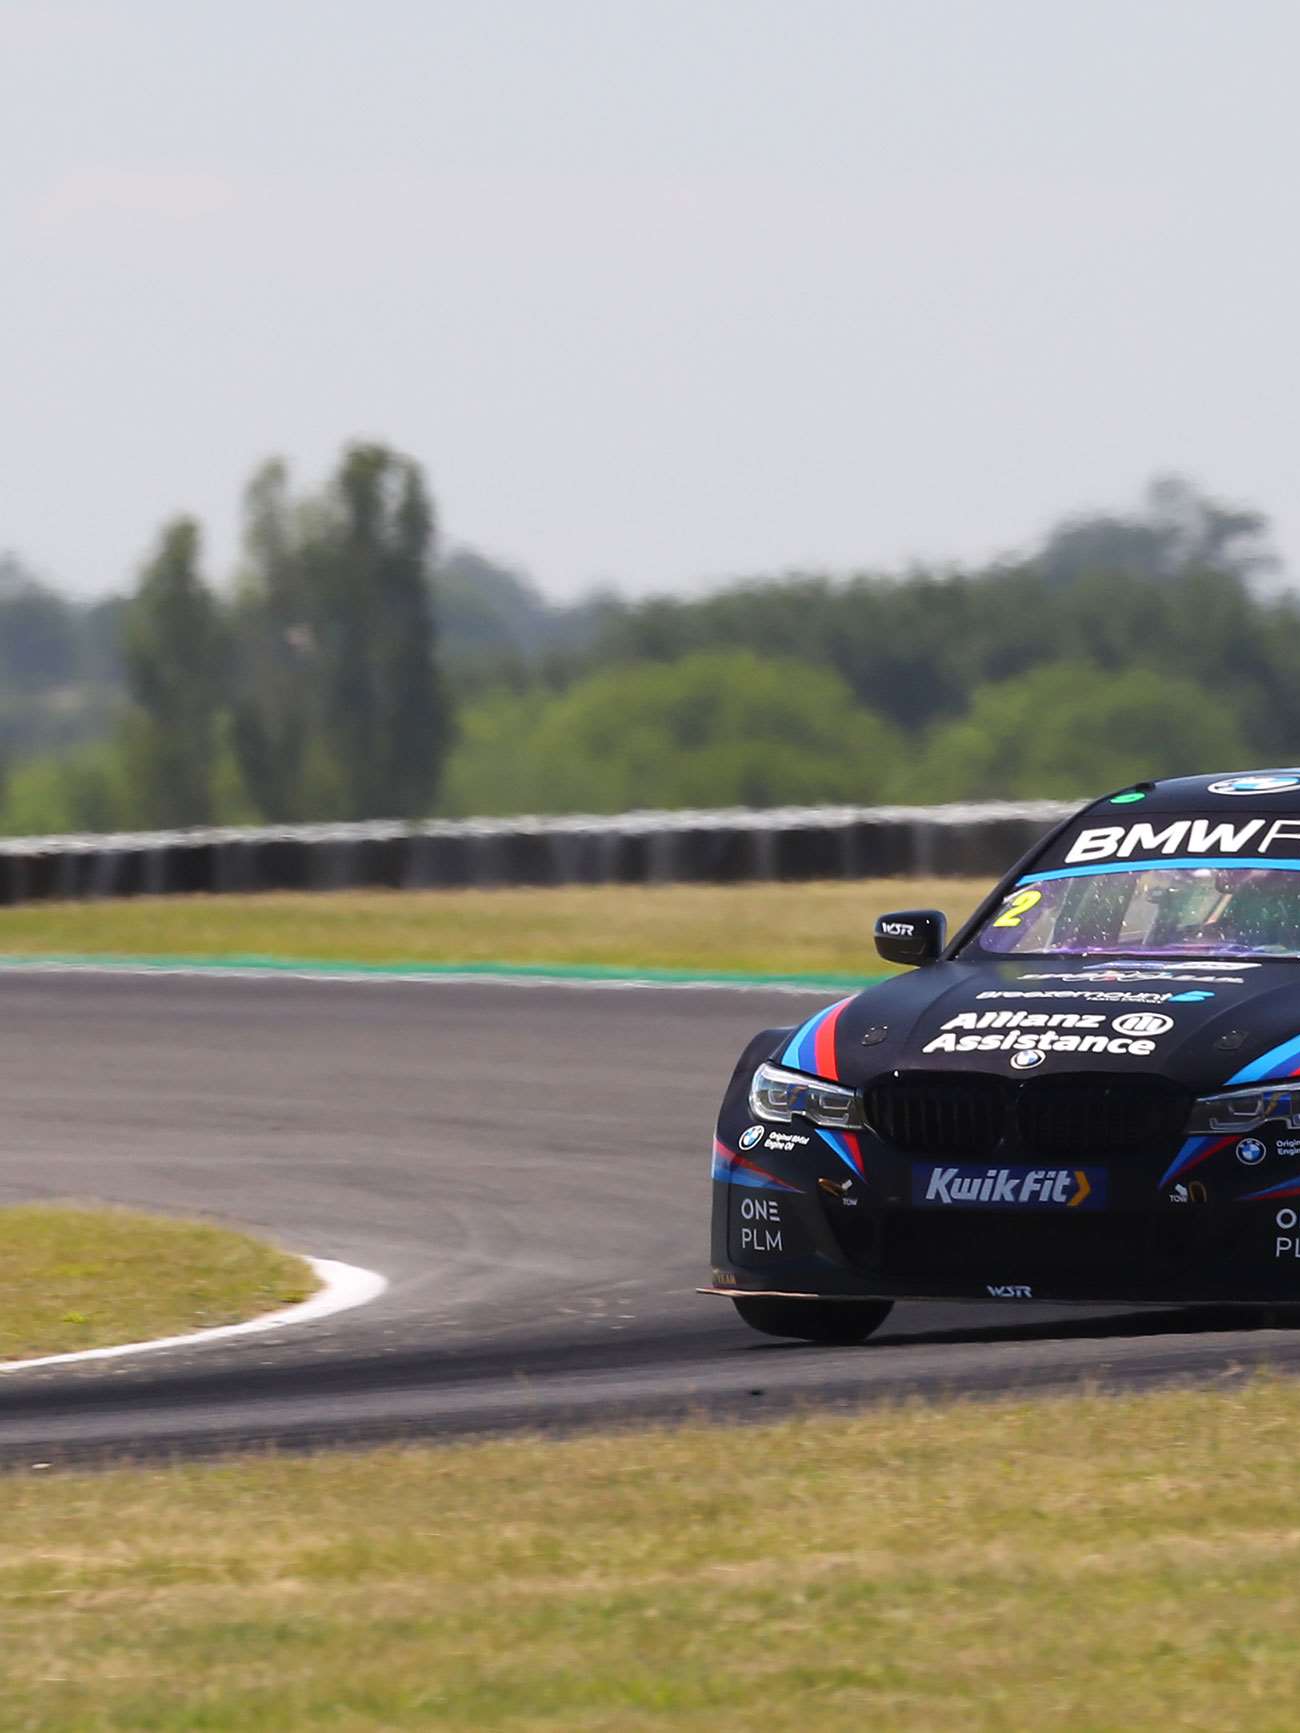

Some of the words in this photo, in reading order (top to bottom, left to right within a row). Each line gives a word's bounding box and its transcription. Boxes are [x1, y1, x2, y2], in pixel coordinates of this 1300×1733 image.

[993, 890, 1042, 927] 2
[940, 1011, 1107, 1029] Allianz
[922, 1030, 1156, 1055] Assistance
[741, 1199, 781, 1222] ONE
[1169, 1195, 1187, 1203] TOW
[741, 1228, 783, 1251] PLM
[987, 1285, 1032, 1297] WSR
